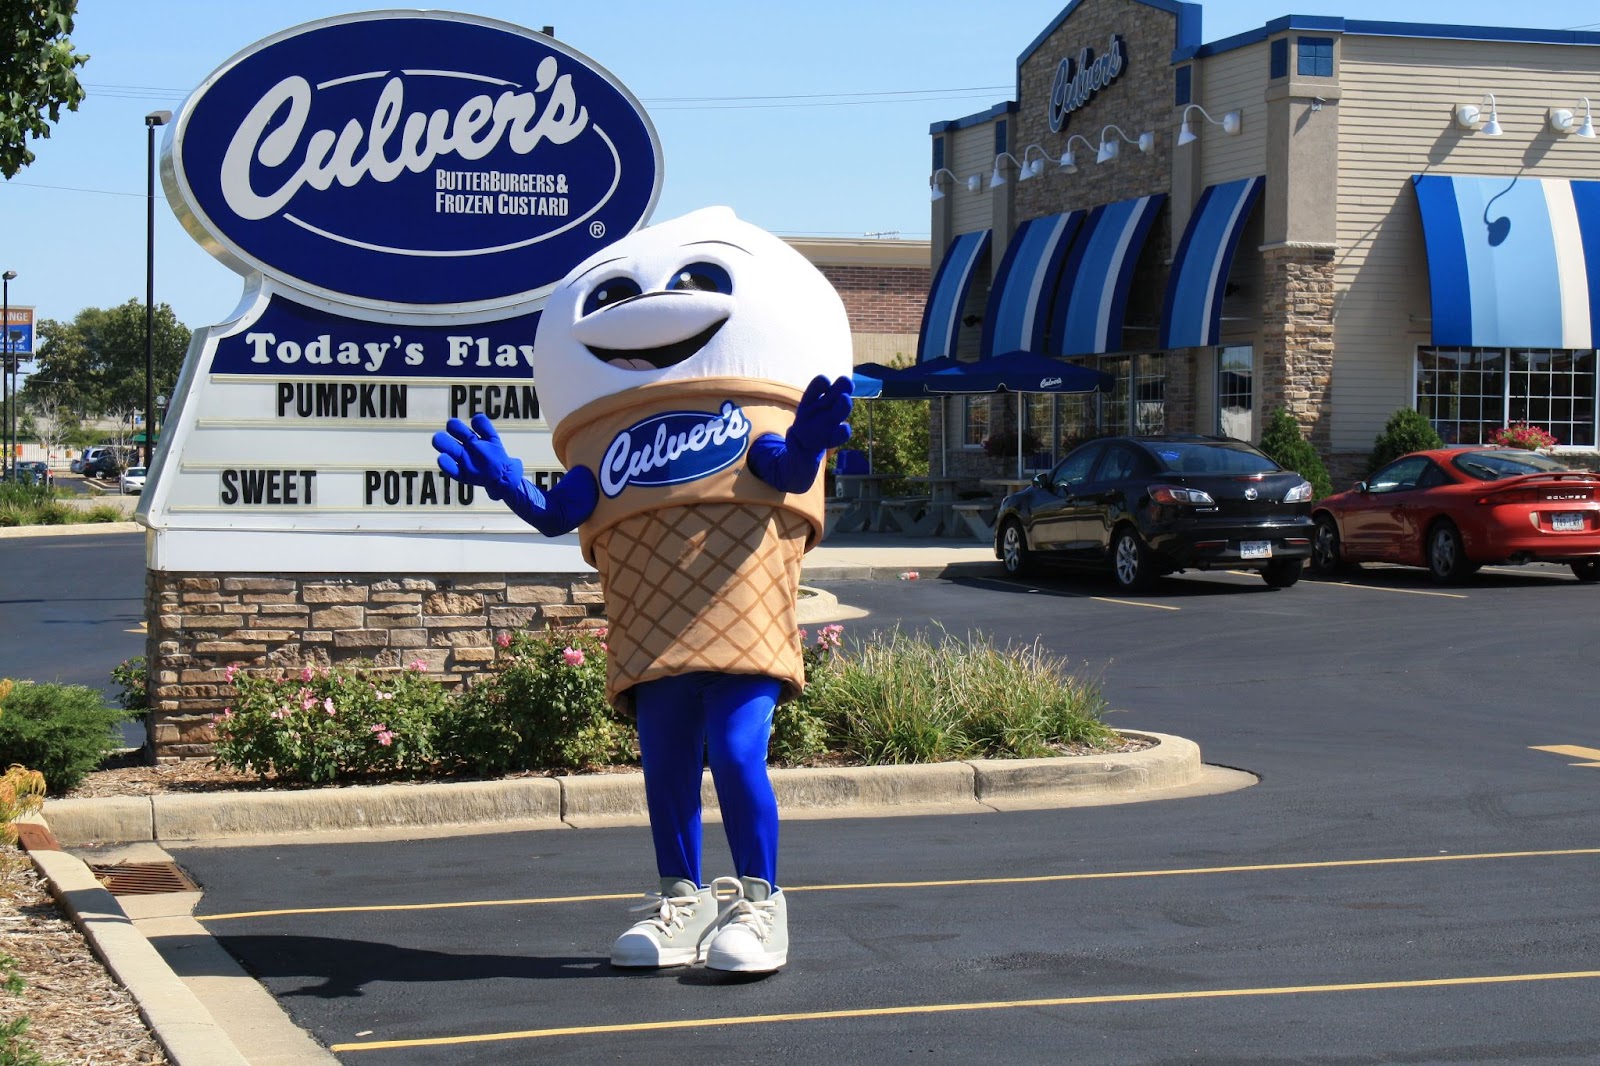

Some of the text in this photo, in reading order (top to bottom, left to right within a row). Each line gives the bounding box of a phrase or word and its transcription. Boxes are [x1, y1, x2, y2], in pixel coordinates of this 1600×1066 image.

[1048, 33, 1123, 133] Culver's
[220, 56, 588, 220] Culver's
[245, 332, 425, 372] Today's
[278, 383, 540, 420] PUMPKIN PECAN
[601, 402, 749, 497] Culver's
[221, 470, 317, 505] SWEET
